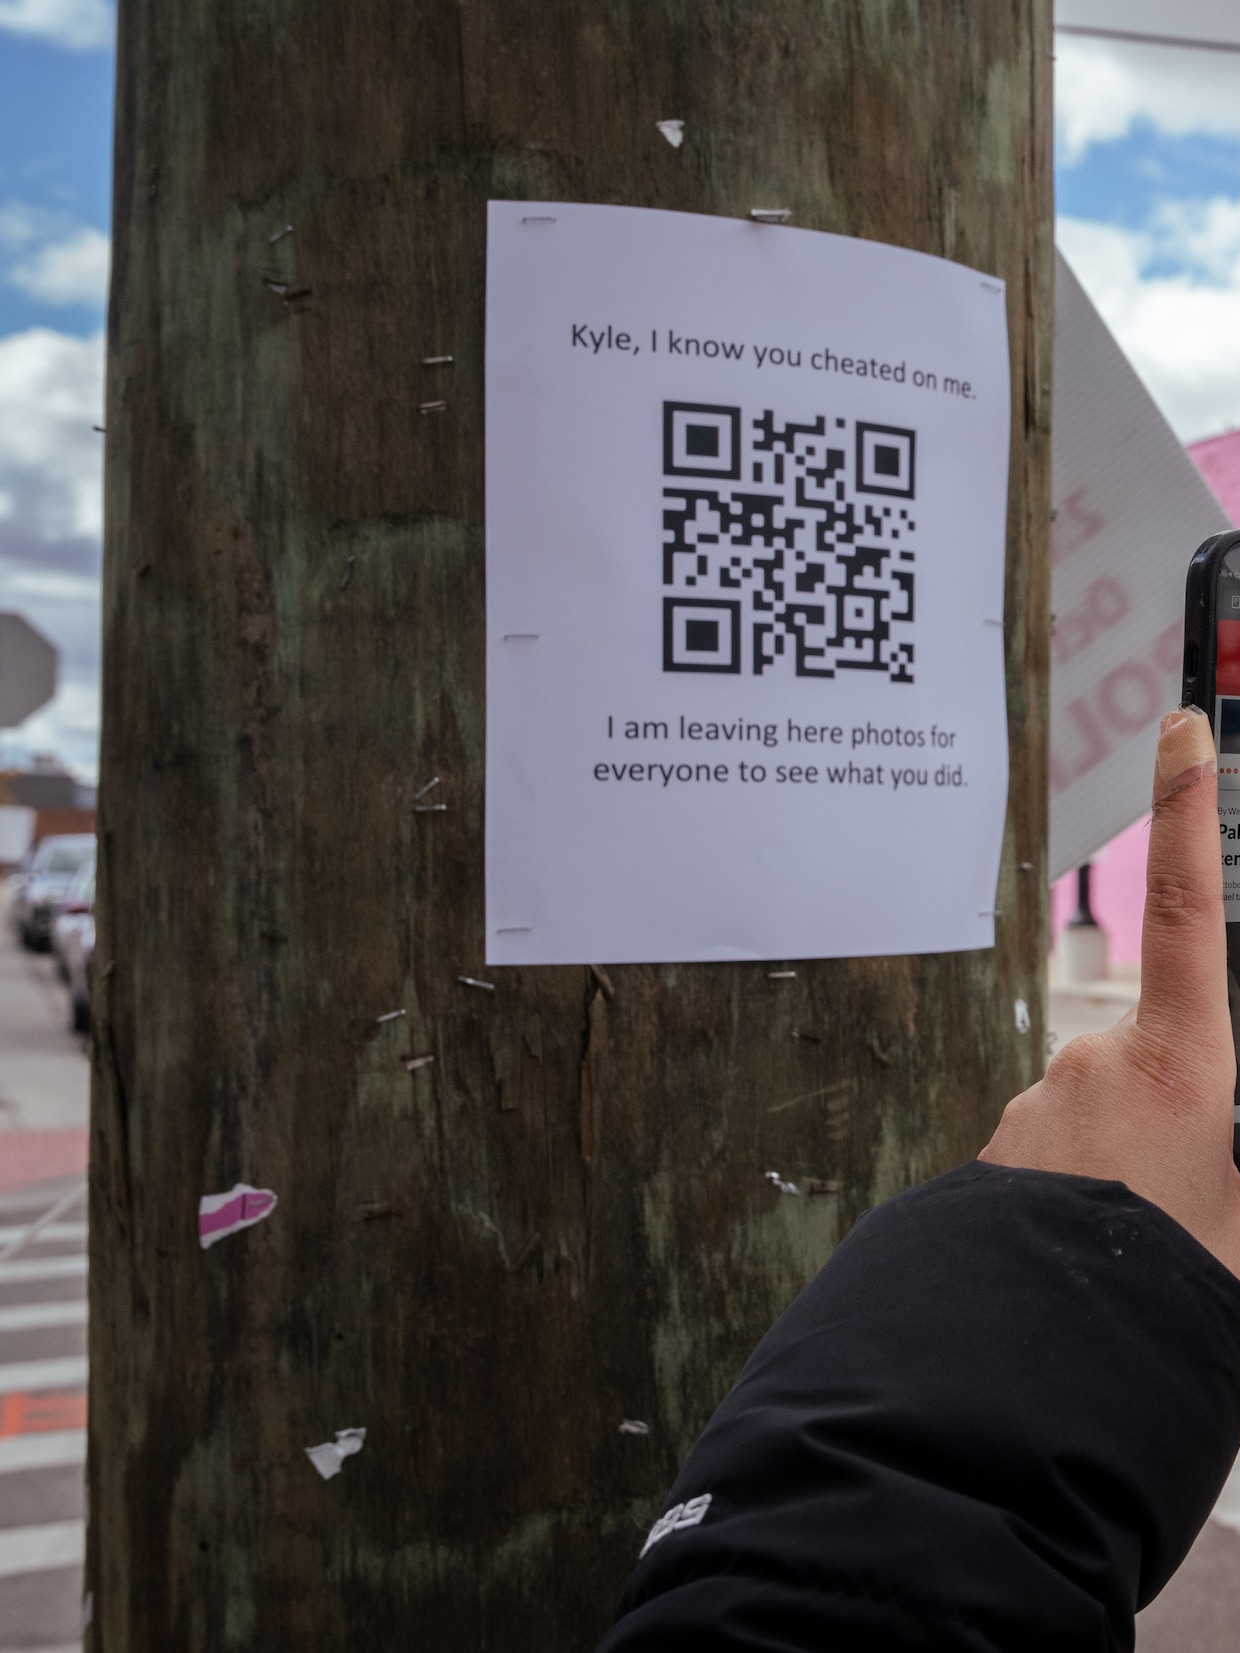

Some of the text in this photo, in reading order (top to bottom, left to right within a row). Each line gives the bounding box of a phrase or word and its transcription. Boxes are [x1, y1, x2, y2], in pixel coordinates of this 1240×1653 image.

[571, 323, 979, 399] Kyle, I know you cheated on me.
[607, 714, 957, 750] I am leaving here photos for
[592, 760, 968, 791] everyone to see what you did.
[1218, 807, 1227, 816] By
